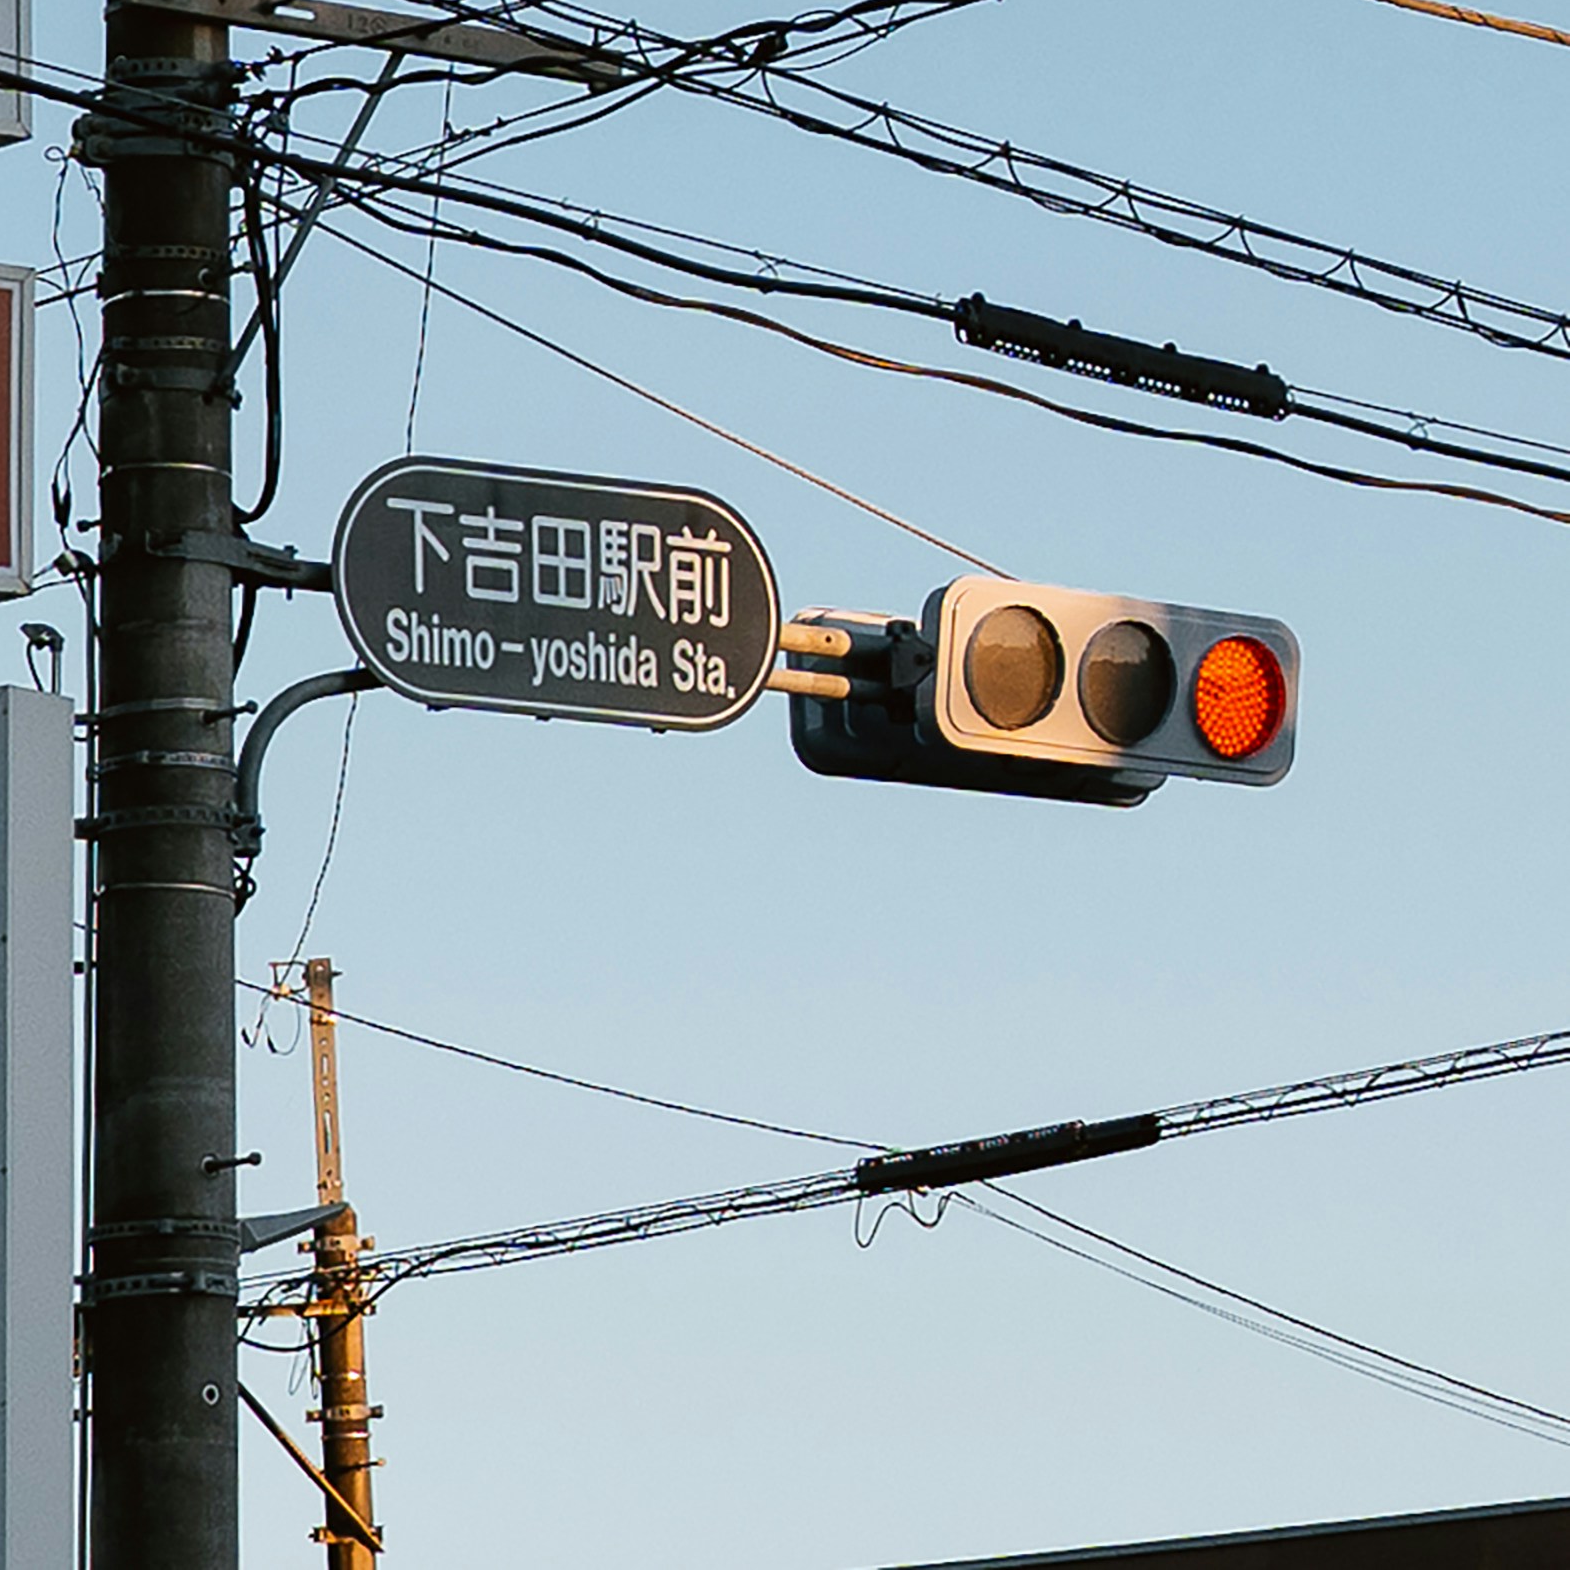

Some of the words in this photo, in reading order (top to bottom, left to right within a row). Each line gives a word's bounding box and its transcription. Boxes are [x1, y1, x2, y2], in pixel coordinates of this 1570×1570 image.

[386, 497, 732, 629] 下吉田駅前
[673, 638, 736, 698] Sta.
